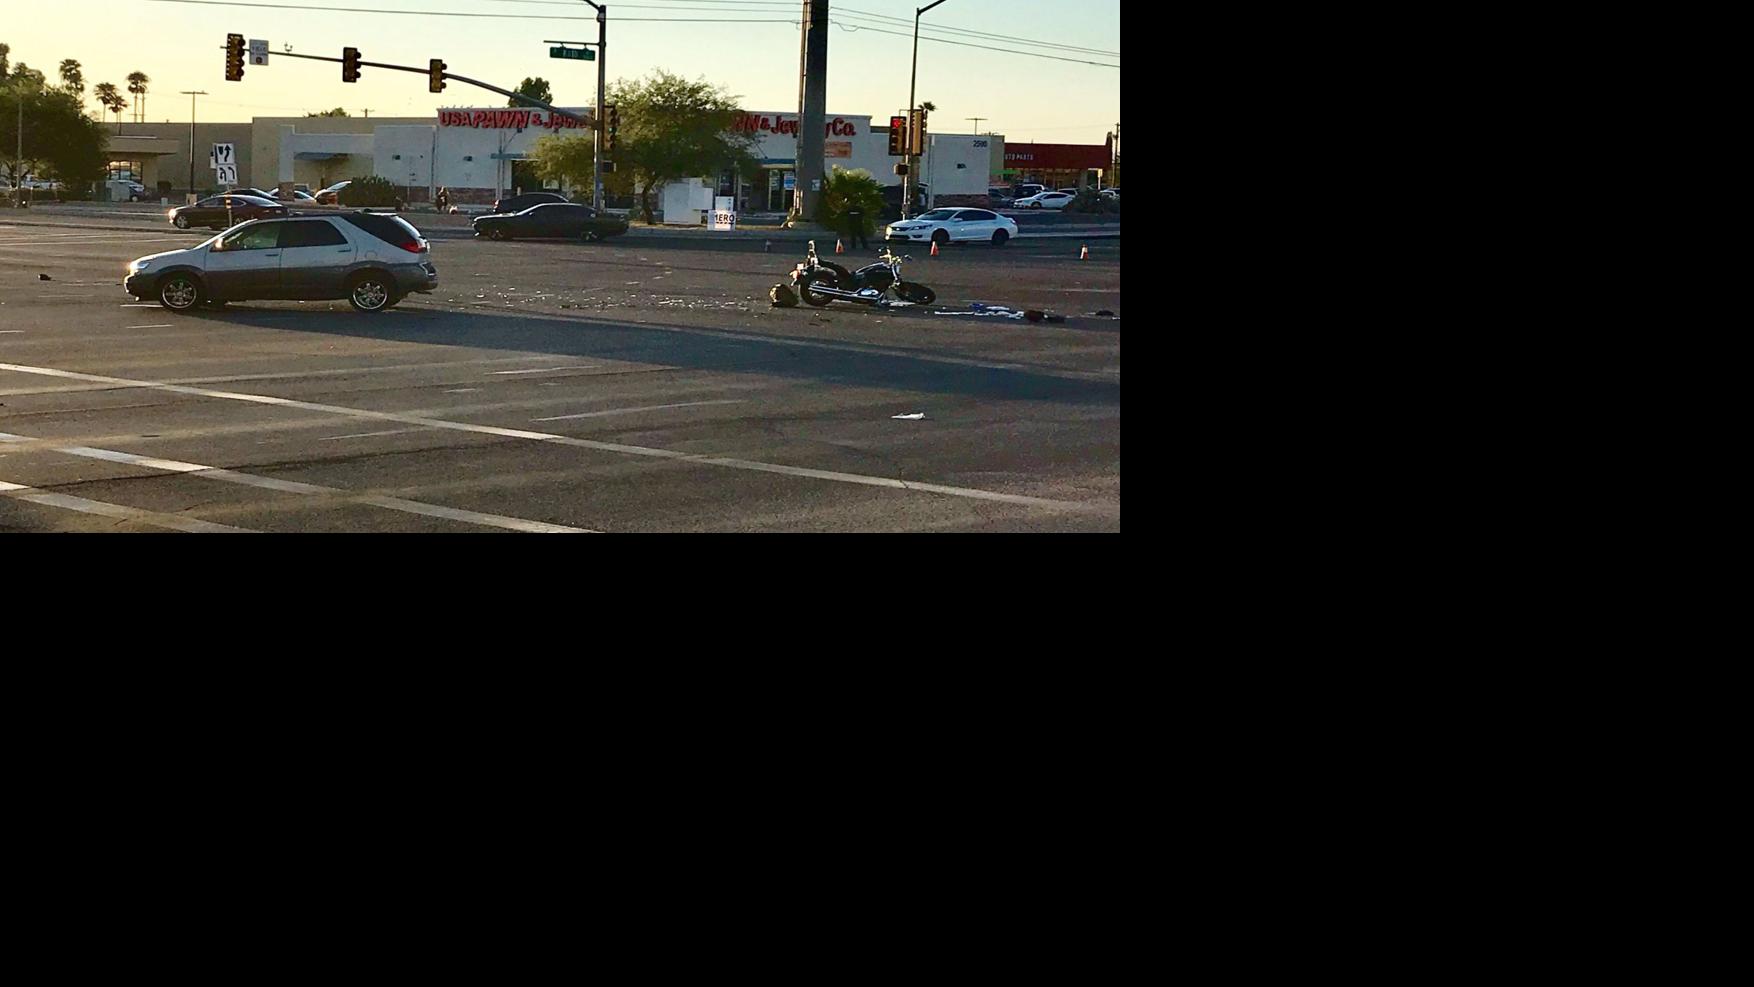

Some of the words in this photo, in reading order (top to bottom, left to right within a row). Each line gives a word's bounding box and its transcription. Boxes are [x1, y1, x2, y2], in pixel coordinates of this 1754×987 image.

[439, 110, 472, 127] USA
[472, 110, 530, 129] PAWN
[531, 112, 543, 126] &
[832, 117, 857, 137] Co.
